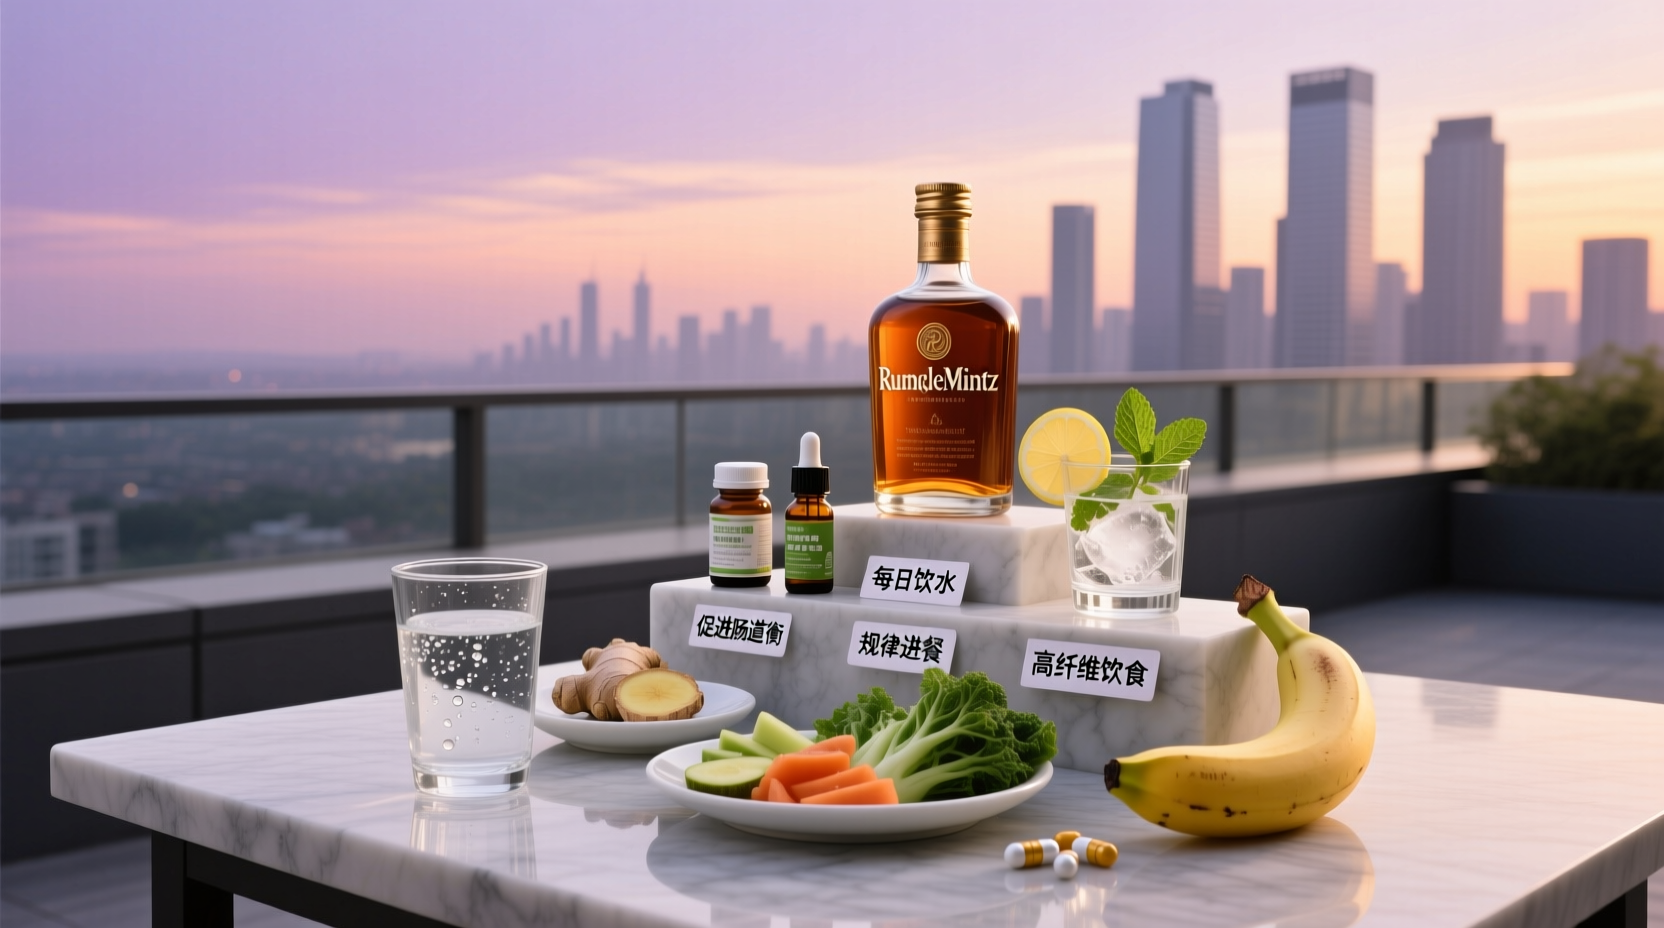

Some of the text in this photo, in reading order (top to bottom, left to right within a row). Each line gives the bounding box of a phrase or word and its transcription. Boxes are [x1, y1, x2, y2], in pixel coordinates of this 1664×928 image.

[872, 565, 956, 594] 每日饮水
[858, 631, 944, 664] 规律进餐
[1032, 649, 1149, 687] 高纤维饮食
